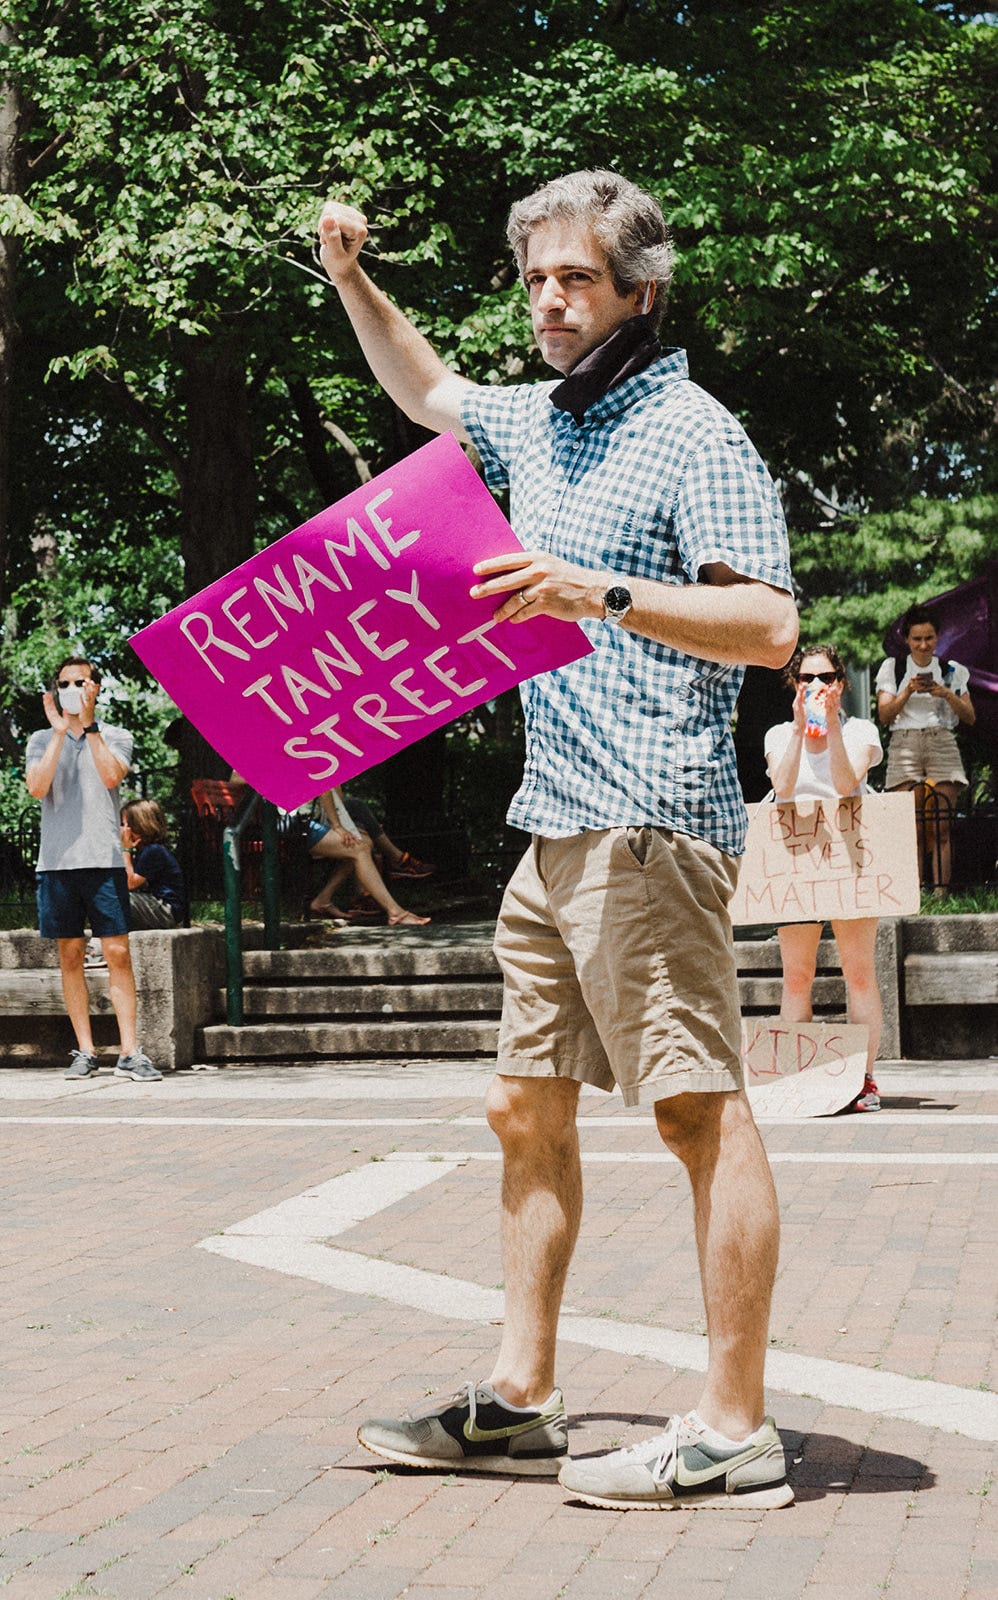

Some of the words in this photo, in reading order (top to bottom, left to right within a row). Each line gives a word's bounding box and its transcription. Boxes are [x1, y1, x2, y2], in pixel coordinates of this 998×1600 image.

[179, 488, 421, 683] RENAME
[242, 569, 441, 725] TANEY
[283, 618, 517, 780] STREET
[761, 838, 874, 879] LIVES
[769, 802, 869, 842] BLACK
[745, 873, 901, 919] MATTER
